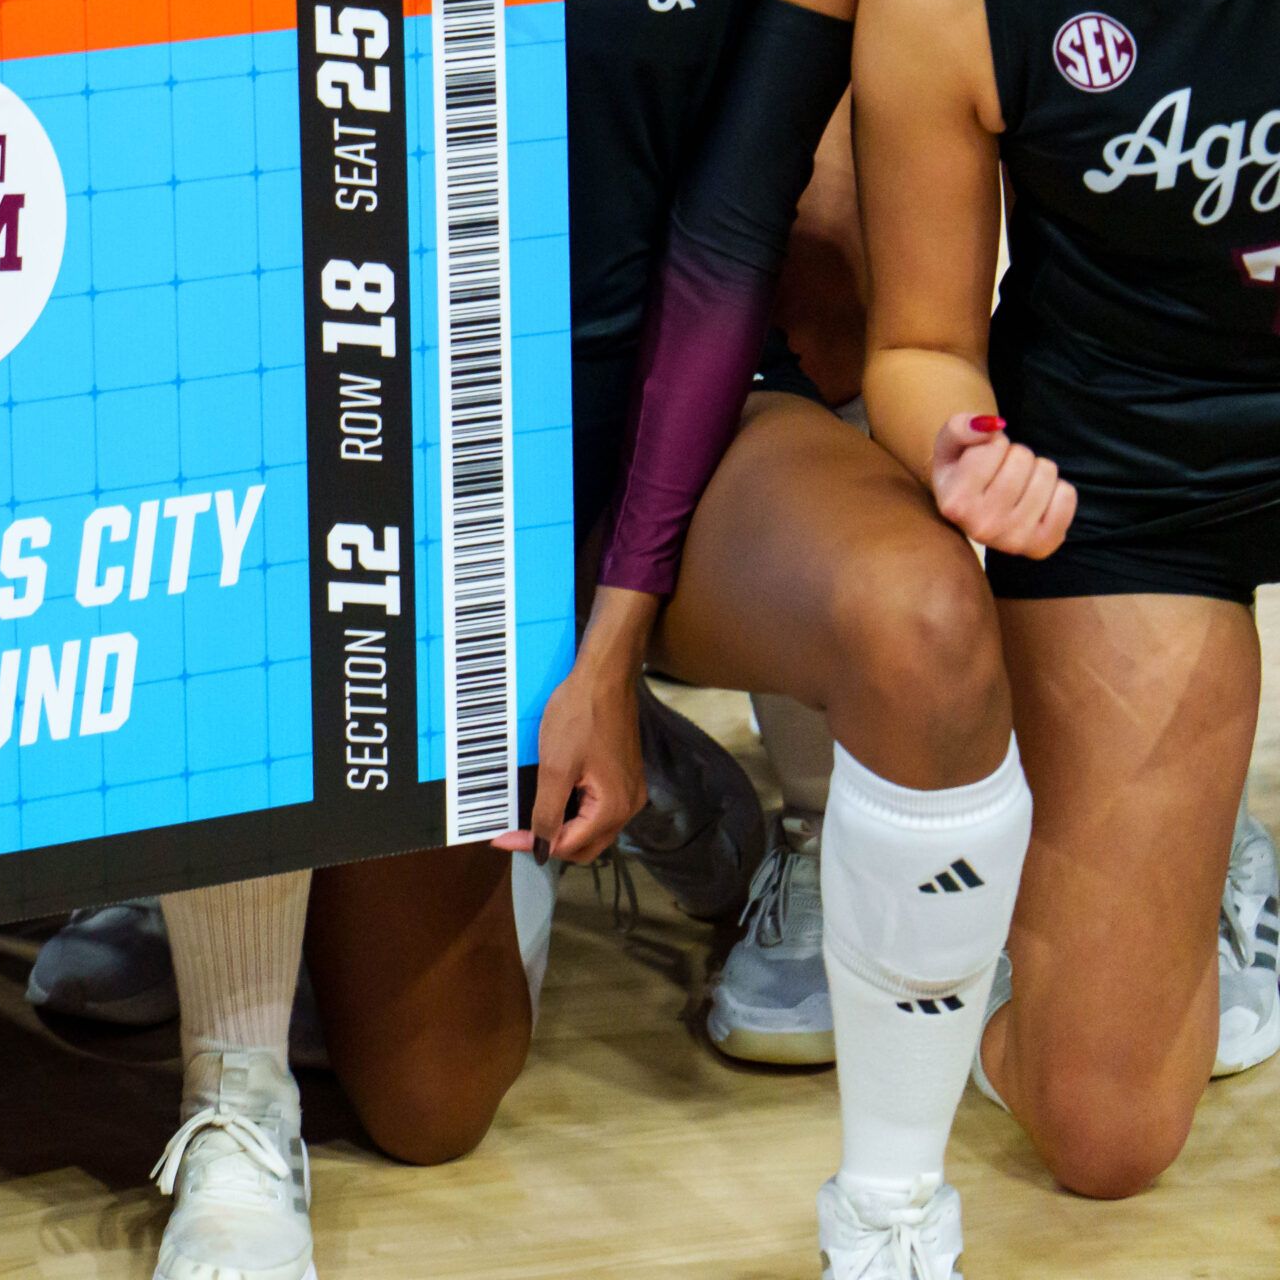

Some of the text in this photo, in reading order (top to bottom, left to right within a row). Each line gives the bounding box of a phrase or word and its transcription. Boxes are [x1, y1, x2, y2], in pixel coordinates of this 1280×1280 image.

[314, 4, 391, 212] SEAT 25
[1057, 17, 1132, 89] SEC
[321, 258, 396, 462] ROW 18
[75, 485, 267, 608] CITY
[327, 523, 401, 791] SECTION 12
